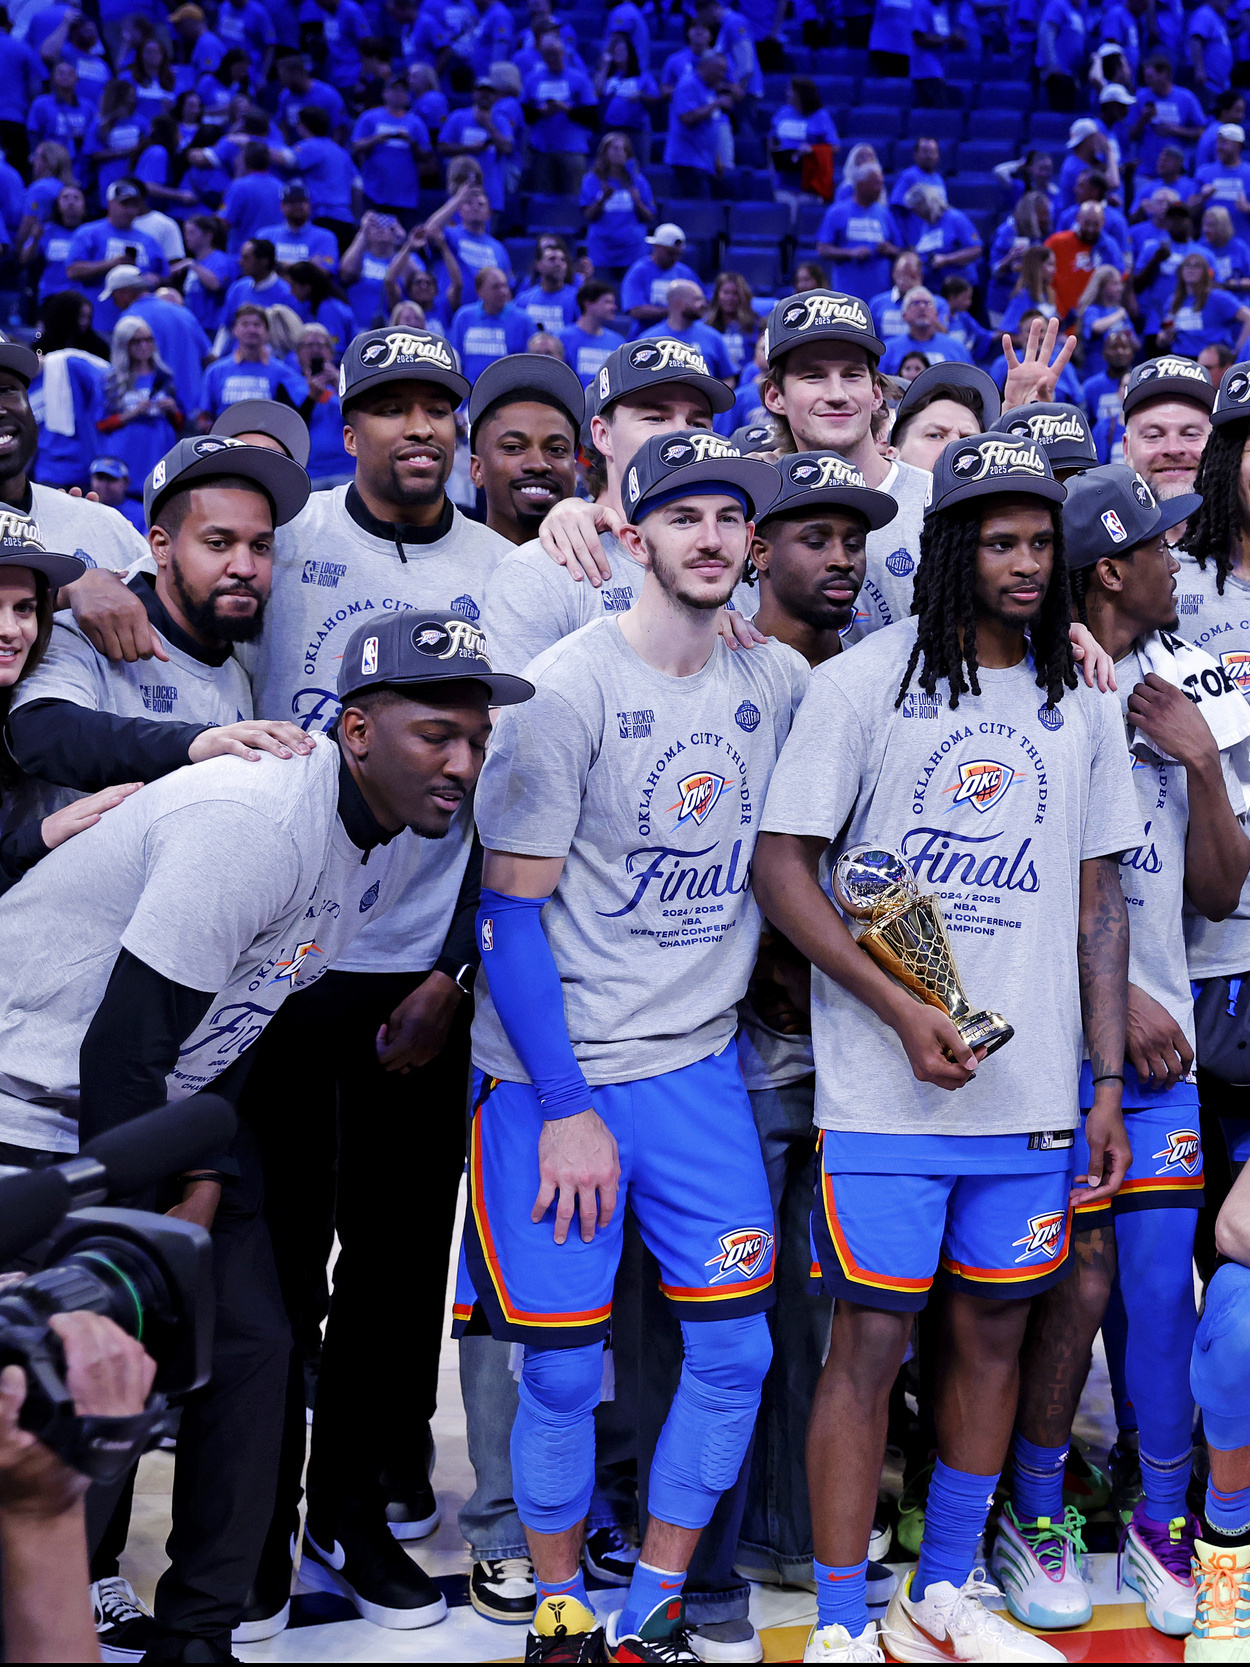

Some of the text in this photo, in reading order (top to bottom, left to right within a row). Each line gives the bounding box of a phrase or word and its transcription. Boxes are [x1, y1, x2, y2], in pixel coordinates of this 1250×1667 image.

[798, 296, 868, 331] Finals
[814, 317, 831, 326] 2025
[378, 332, 452, 370] Finals
[396, 355, 414, 364] 2025
[1028, 412, 1086, 445] Finals
[972, 440, 1046, 481] Finals
[989, 466, 1007, 475] 2025
[3, 536, 22, 547] 2025
[319, 561, 347, 577] LOCKER
[886, 556, 915, 572] WESTERN
[317, 574, 339, 589] ROOM
[1181, 594, 1204, 605] LOCKER
[451, 601, 481, 621] WESTERN
[1180, 604, 1199, 615] ROOM
[304, 598, 375, 675] OKLAHOMA
[459, 648, 476, 659] 2025
[152, 685, 178, 701] LOCKER
[918, 692, 943, 707] LOCKER
[152, 699, 173, 714] ROOM
[918, 705, 939, 720] ROOM
[631, 709, 656, 724] LOCKER
[632, 723, 652, 739] ROOM
[912, 722, 1048, 825] OKLAHOMA CITY THUNDER
[638, 741, 686, 837] OKLAHOMA
[690, 732, 723, 748] CITY
[955, 769, 1001, 802] OKC
[679, 780, 713, 819] OKC
[901, 827, 1041, 893] Finals
[953, 902, 978, 912] NBA
[682, 917, 702, 926] NBA
[954, 913, 1022, 929] CONFERENCE
[630, 928, 680, 939] WESTERN
[946, 924, 995, 936] AMPIONS
[658, 935, 724, 948] CHAMPIONS
[725, 1236, 762, 1268] OKC
